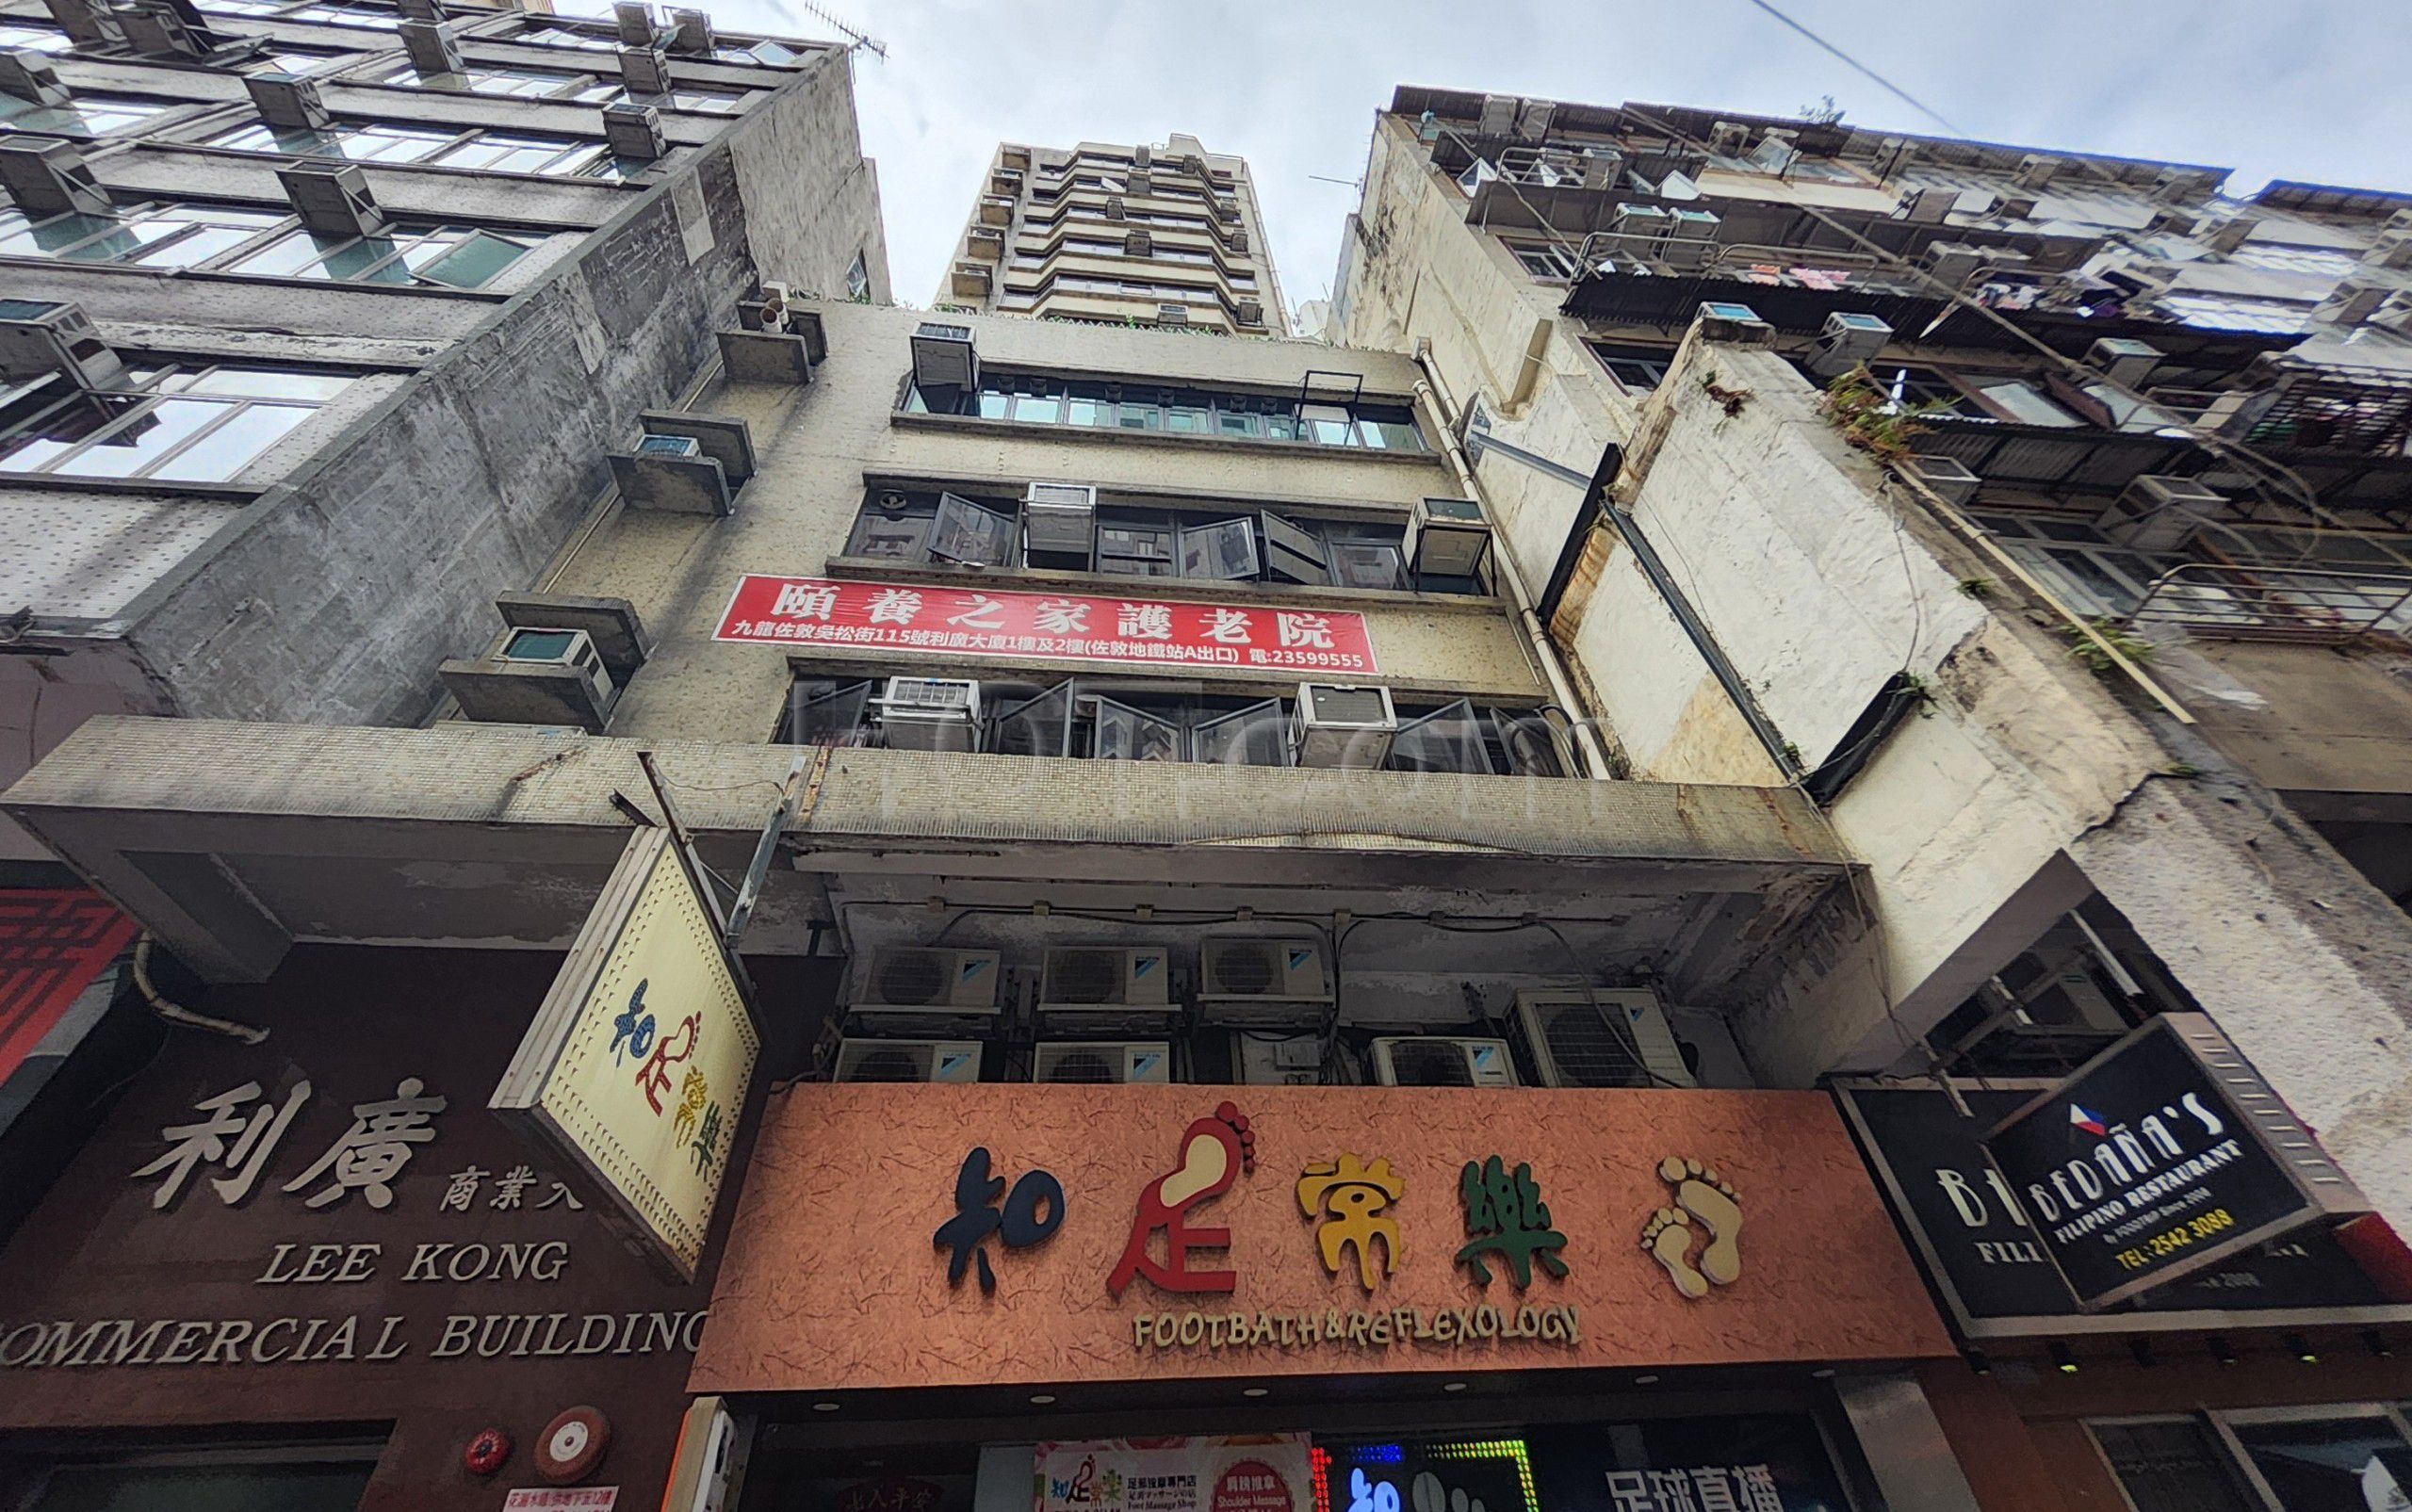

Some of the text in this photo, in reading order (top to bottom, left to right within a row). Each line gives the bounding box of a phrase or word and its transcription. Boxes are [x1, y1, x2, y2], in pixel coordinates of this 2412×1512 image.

[770, 580, 1335, 648] 頤養之家護老院
[2054, 1138, 2244, 1245] FILIPINO RESTAURANT
[255, 1242, 568, 1283] LEE KONG
[0, 1315, 407, 1366] OMMERCIAL
[1605, 1465, 1785, 1512] 足球直播
